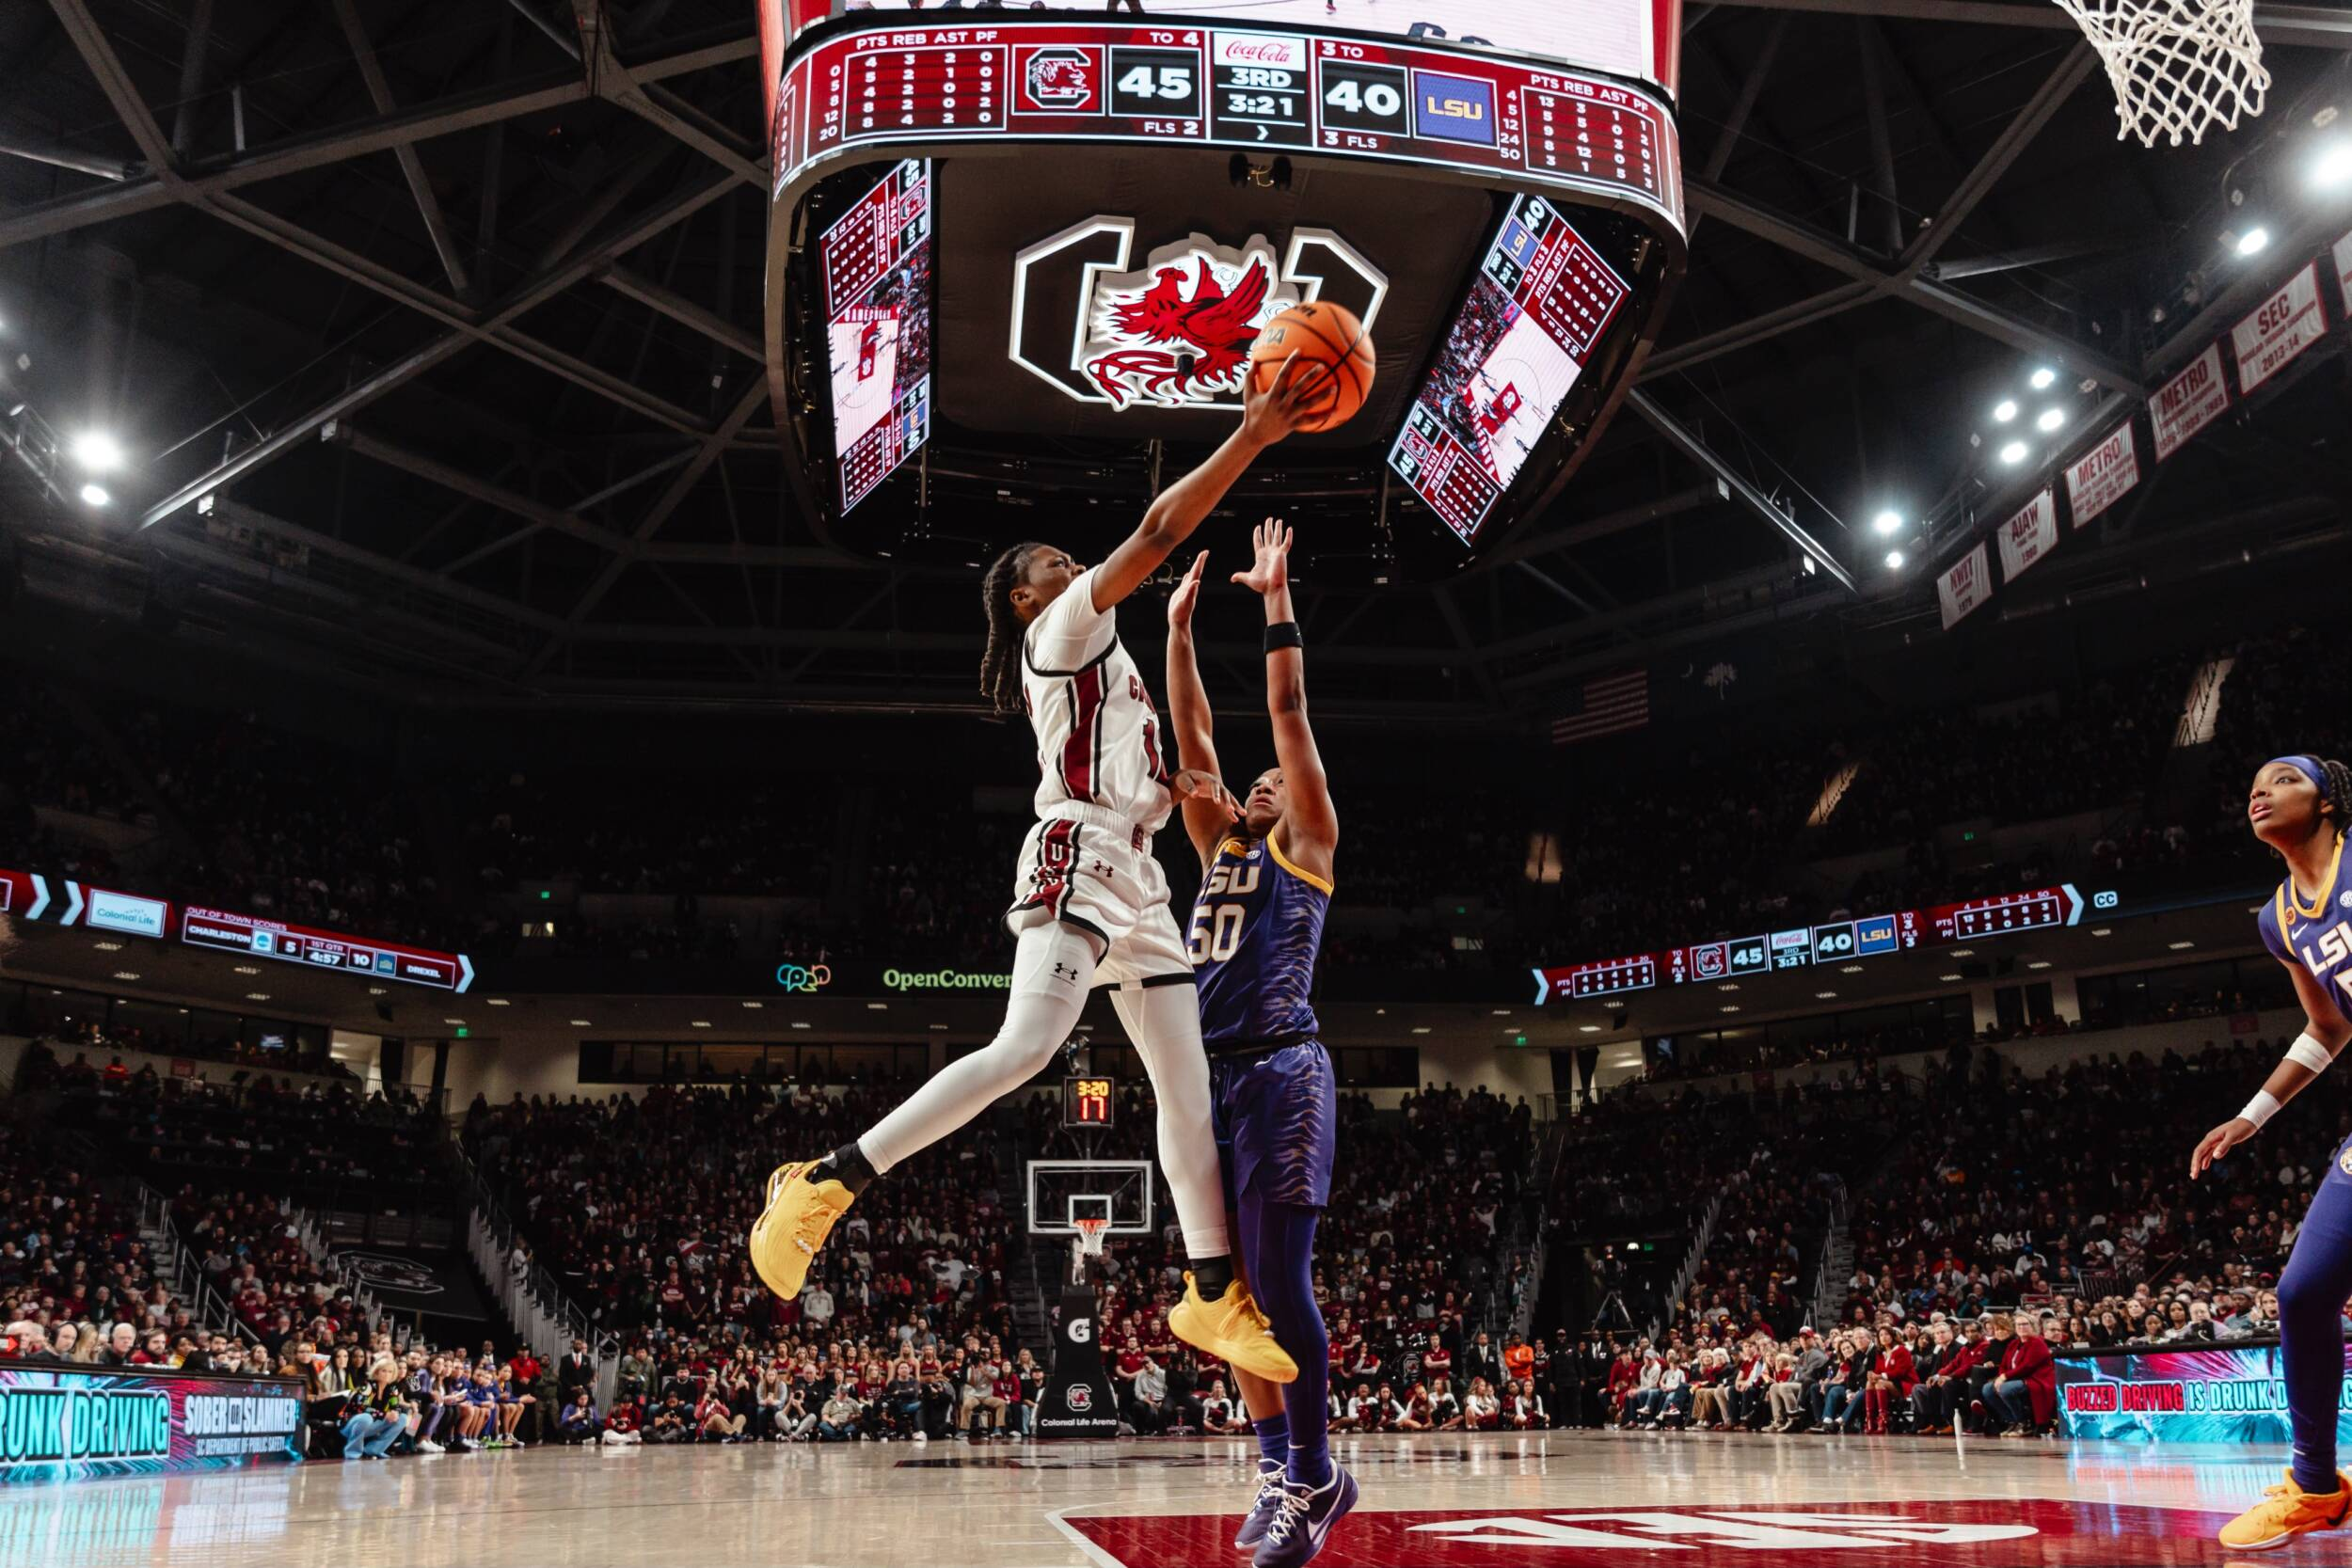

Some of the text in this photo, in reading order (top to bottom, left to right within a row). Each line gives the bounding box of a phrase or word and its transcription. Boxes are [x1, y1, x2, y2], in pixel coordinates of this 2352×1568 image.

[856, 31, 997, 50] PTS REB AST PF
[1150, 32, 1199, 45] TO 4
[1322, 42, 1363, 57] 3 TO
[1226, 40, 1293, 62] Coca-Cola
[830, 52, 993, 77] 0 4 3 2 0
[831, 67, 993, 91] 5 5 2 1 0
[1118, 66, 1191, 99] 45
[1231, 68, 1292, 88] 3RD
[830, 81, 992, 106] 8 4 2 0 3
[1228, 94, 1293, 116] 3:21
[1326, 80, 1401, 116] 40
[1531, 74, 1648, 112] PTS REB AST PF
[824, 97, 991, 123] 12 8 2 0 2
[1427, 96, 1483, 120] LSU
[1507, 90, 1646, 131] 4 13 3 1 1
[819, 112, 992, 141] 20 8 4 2 0
[1144, 120, 1198, 135] FLS 2
[1508, 104, 1648, 146] 5 5 5 0 2
[1325, 132, 1377, 149] 3 FLS
[1503, 119, 1650, 160] 12 9 4 3 0
[1500, 133, 1651, 175] 24 8 12 0 2
[1500, 148, 1652, 189] 50 3 1 5 3
[1524, 200, 1545, 232] 40
[1511, 230, 1527, 257] LSU
[1535, 284, 1547, 299] PTS
[1552, 253, 1565, 270] AST
[1563, 239, 1570, 252] PF
[2258, 293, 2290, 335] SEC
[2160, 360, 2208, 415] METRO
[1400, 453, 1415, 475] 45
[2077, 436, 2120, 486] METRO
[2011, 502, 2039, 542] AIAW
[2096, 895, 2116, 906] CC
[98, 909, 155, 925] Colonial Life
[188, 907, 207, 916] OUT
[224, 913, 251, 925] TOWN
[253, 918, 287, 931] SCORES
[1904, 920, 1913, 928] 3
[1936, 918, 1952, 927] PTS
[189, 926, 251, 943] CHARLESTON
[1187, 905, 1246, 965] 50
[1819, 933, 1851, 953] 40
[1862, 928, 1892, 942] LSU
[1906, 938, 1915, 947] 3
[285, 942, 295, 953] 5
[310, 953, 340, 965] 4:57
[1733, 947, 1763, 966] 45
[354, 954, 370, 966] 10
[1674, 957, 1681, 965] 4
[1778, 956, 1805, 968] 3:21
[1675, 974, 1682, 983] 2
[1077, 1081, 1108, 1097] 3:20
[1081, 1096, 1105, 1120] 17
[1068, 1318, 1090, 1342] G
[2067, 1385, 2117, 1412] BUZZED
[2122, 1383, 2185, 1412] DRIVING
[2188, 1382, 2205, 1412] IS
[2210, 1380, 2270, 1411] DRUNK
[71, 1395, 168, 1455] DRIVING
[184, 1395, 295, 1435] SOBER SLAMMER
